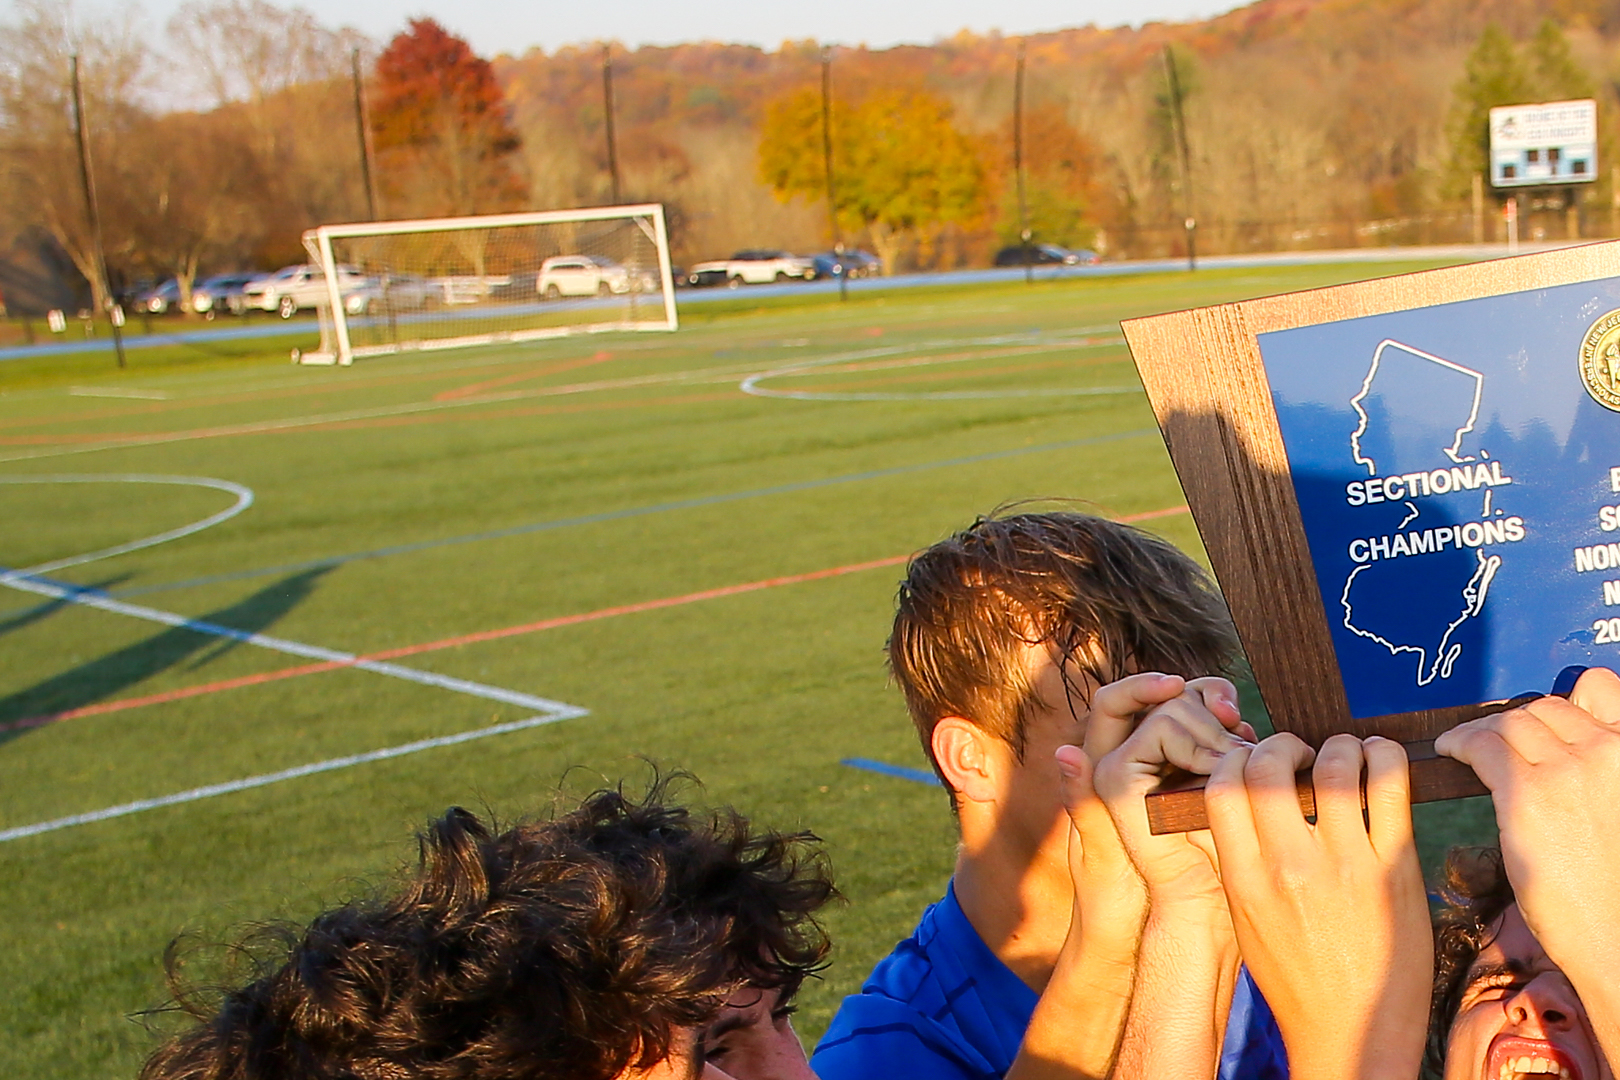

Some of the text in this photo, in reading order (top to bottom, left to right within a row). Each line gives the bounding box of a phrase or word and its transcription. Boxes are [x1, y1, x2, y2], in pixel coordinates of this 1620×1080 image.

[1588, 323, 1607, 347] NEW
[1346, 460, 1513, 507] SECTIONAL
[1348, 515, 1527, 564] CHAMPIONS
